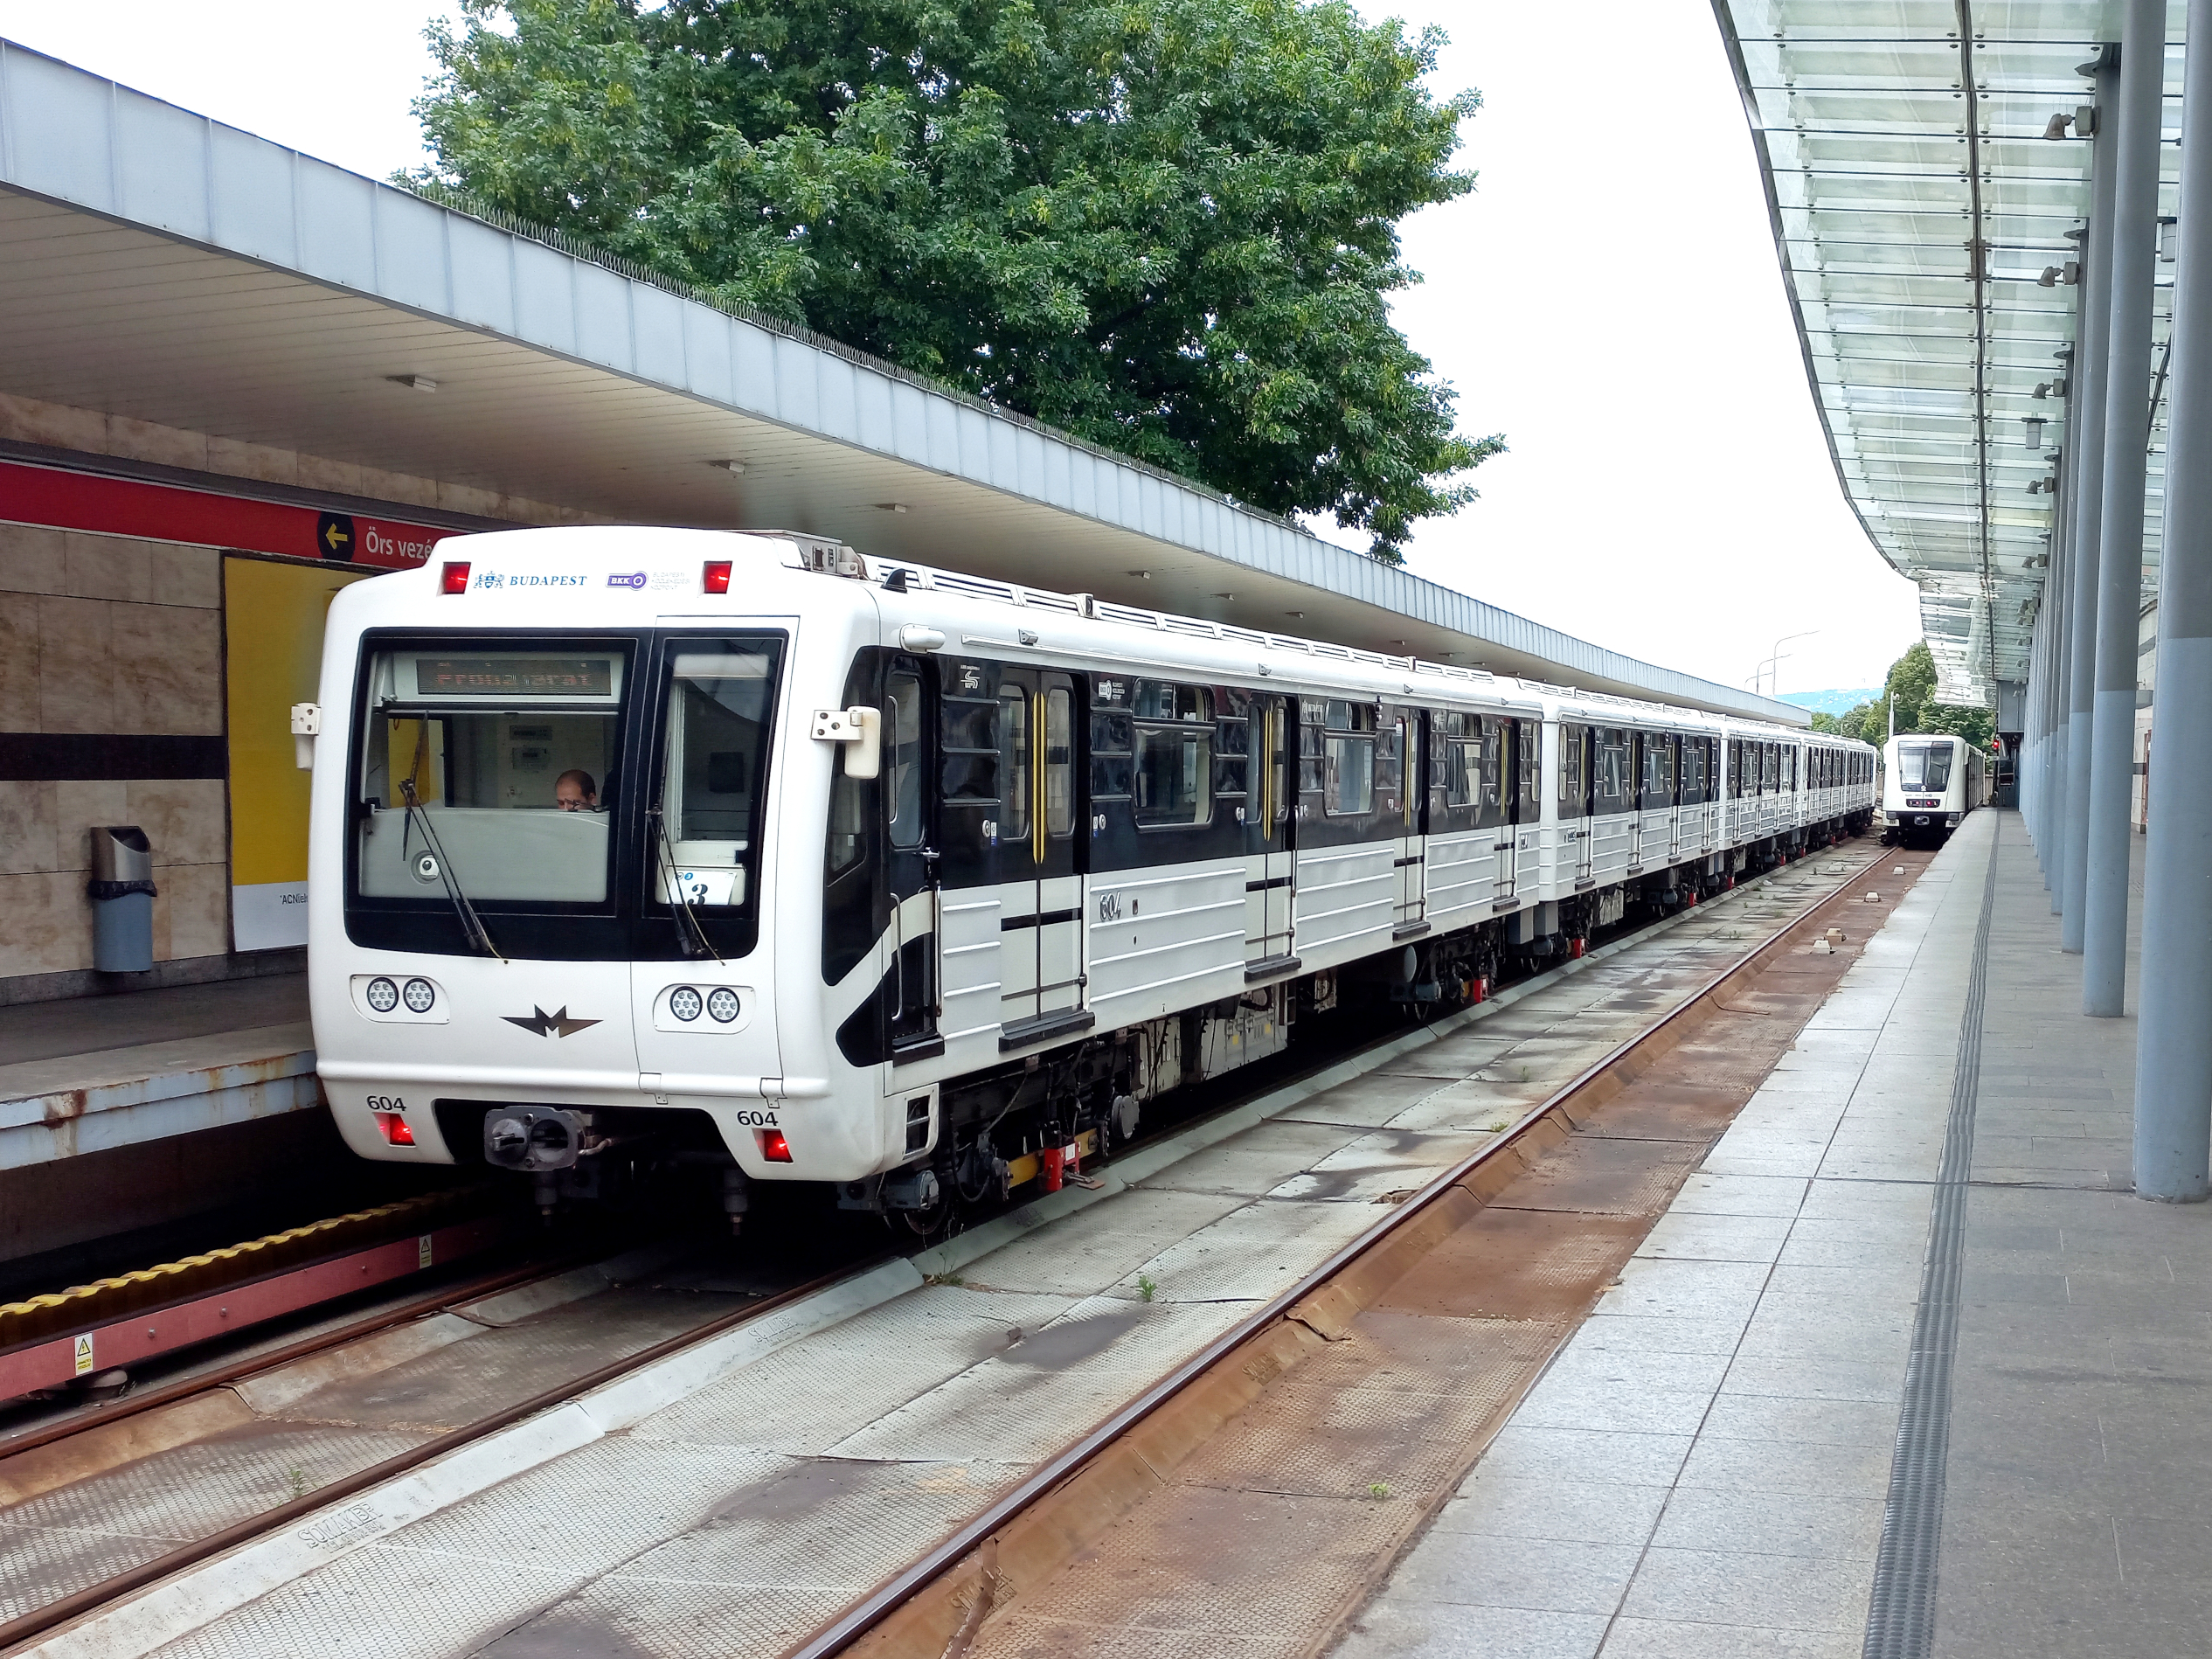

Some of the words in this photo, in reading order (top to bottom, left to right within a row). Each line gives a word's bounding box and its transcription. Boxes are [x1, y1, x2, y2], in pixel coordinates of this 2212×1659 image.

[365, 526, 393, 556] Örs
[510, 576, 587, 587] BUDAPEST
[687, 884, 708, 905] 3
[367, 1095, 406, 1111] 604
[737, 1110, 779, 1127] 604
[297, 1501, 384, 1549] SOMAKER
